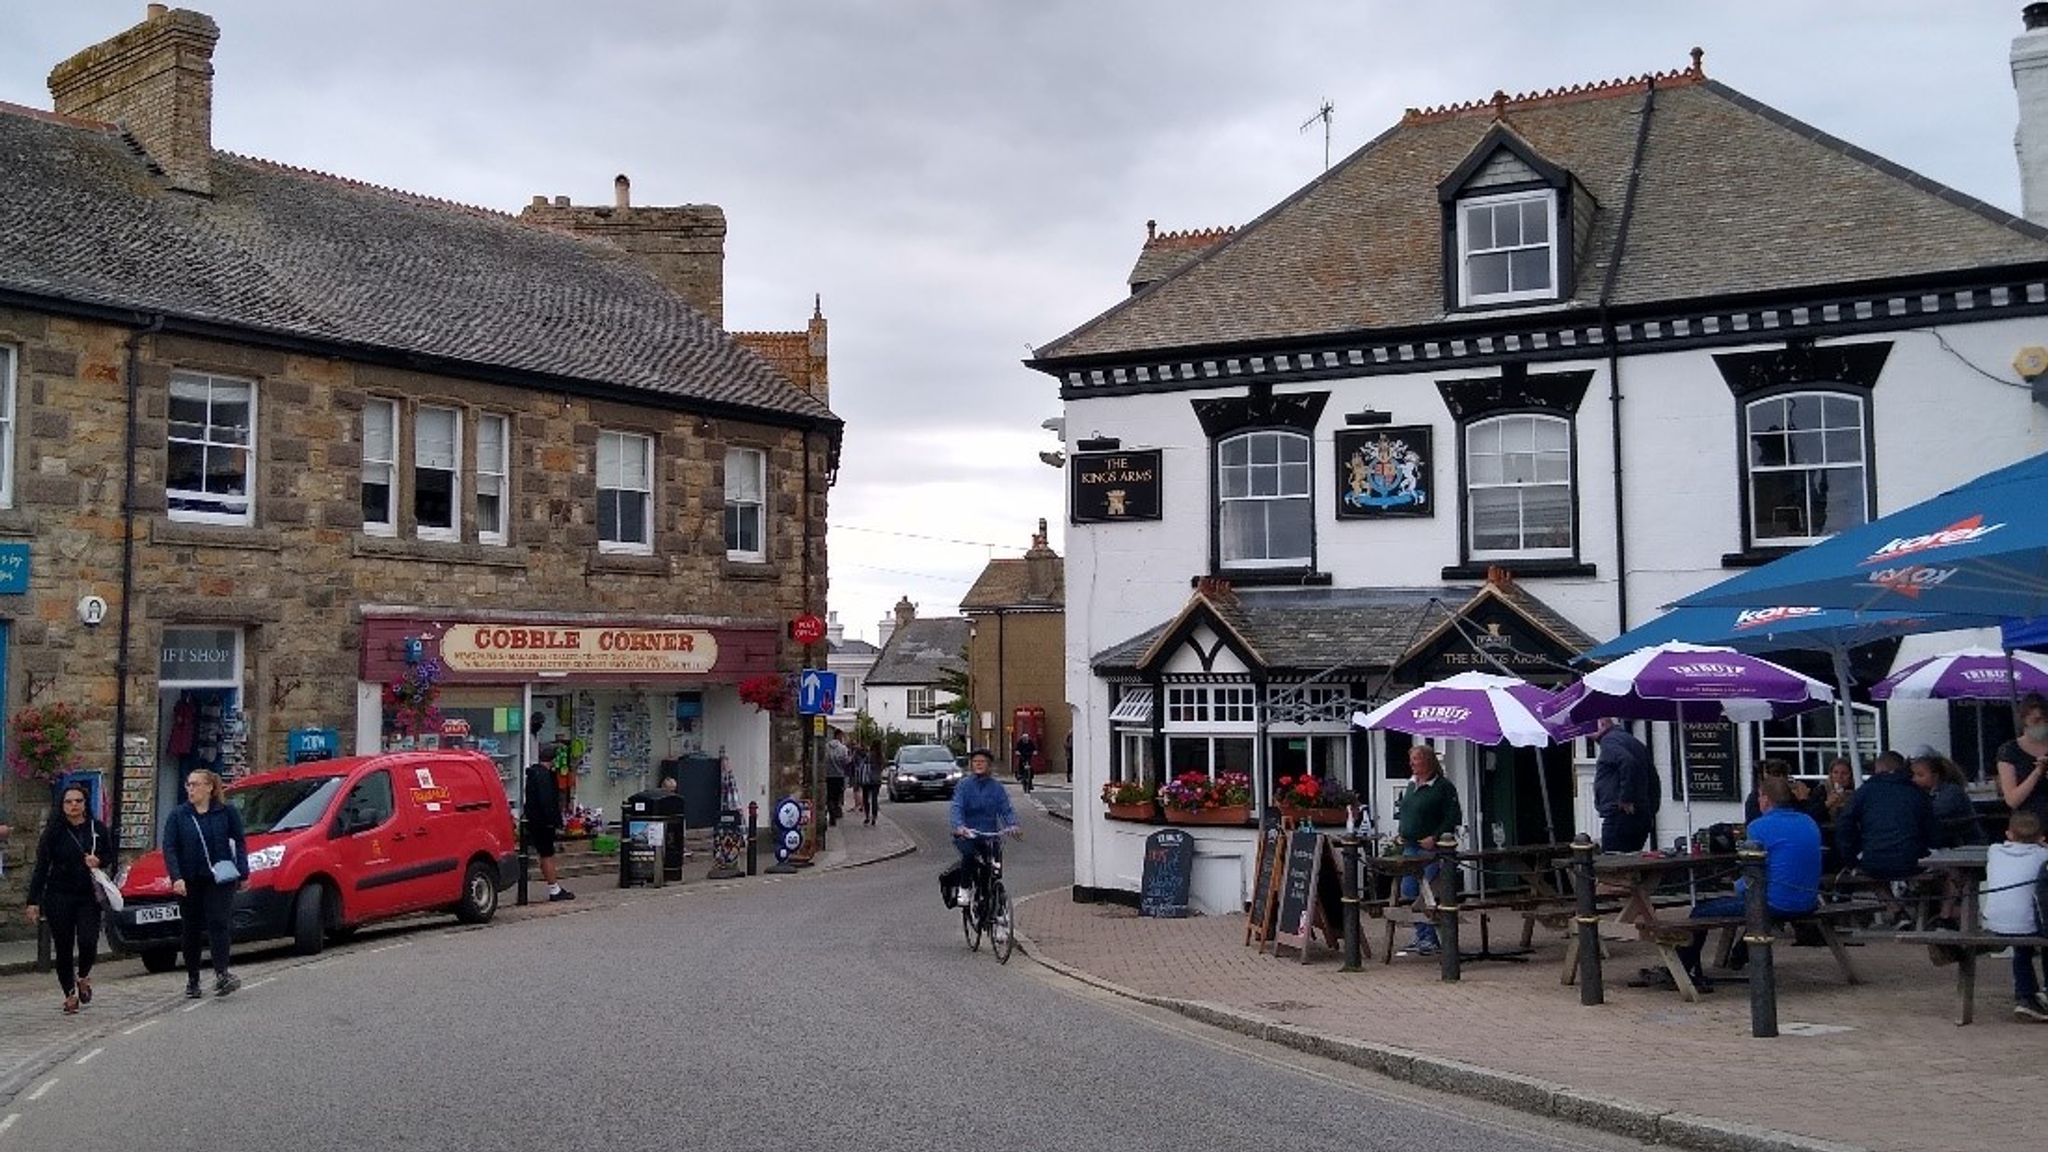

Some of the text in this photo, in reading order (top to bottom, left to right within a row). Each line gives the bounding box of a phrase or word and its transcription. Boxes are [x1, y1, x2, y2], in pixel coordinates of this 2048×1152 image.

[1104, 458, 1128, 470] THE
[1081, 469, 1152, 483] KINGS ARMS
[474, 629, 695, 653] COBBLE CORNER
[162, 647, 229, 662] IFT SHOP
[1443, 653, 1469, 664] THE
[1668, 663, 1746, 675] TRIBUTE
[1411, 706, 1473, 721] TRIBUTE
[1693, 772, 1711, 781] TEA
